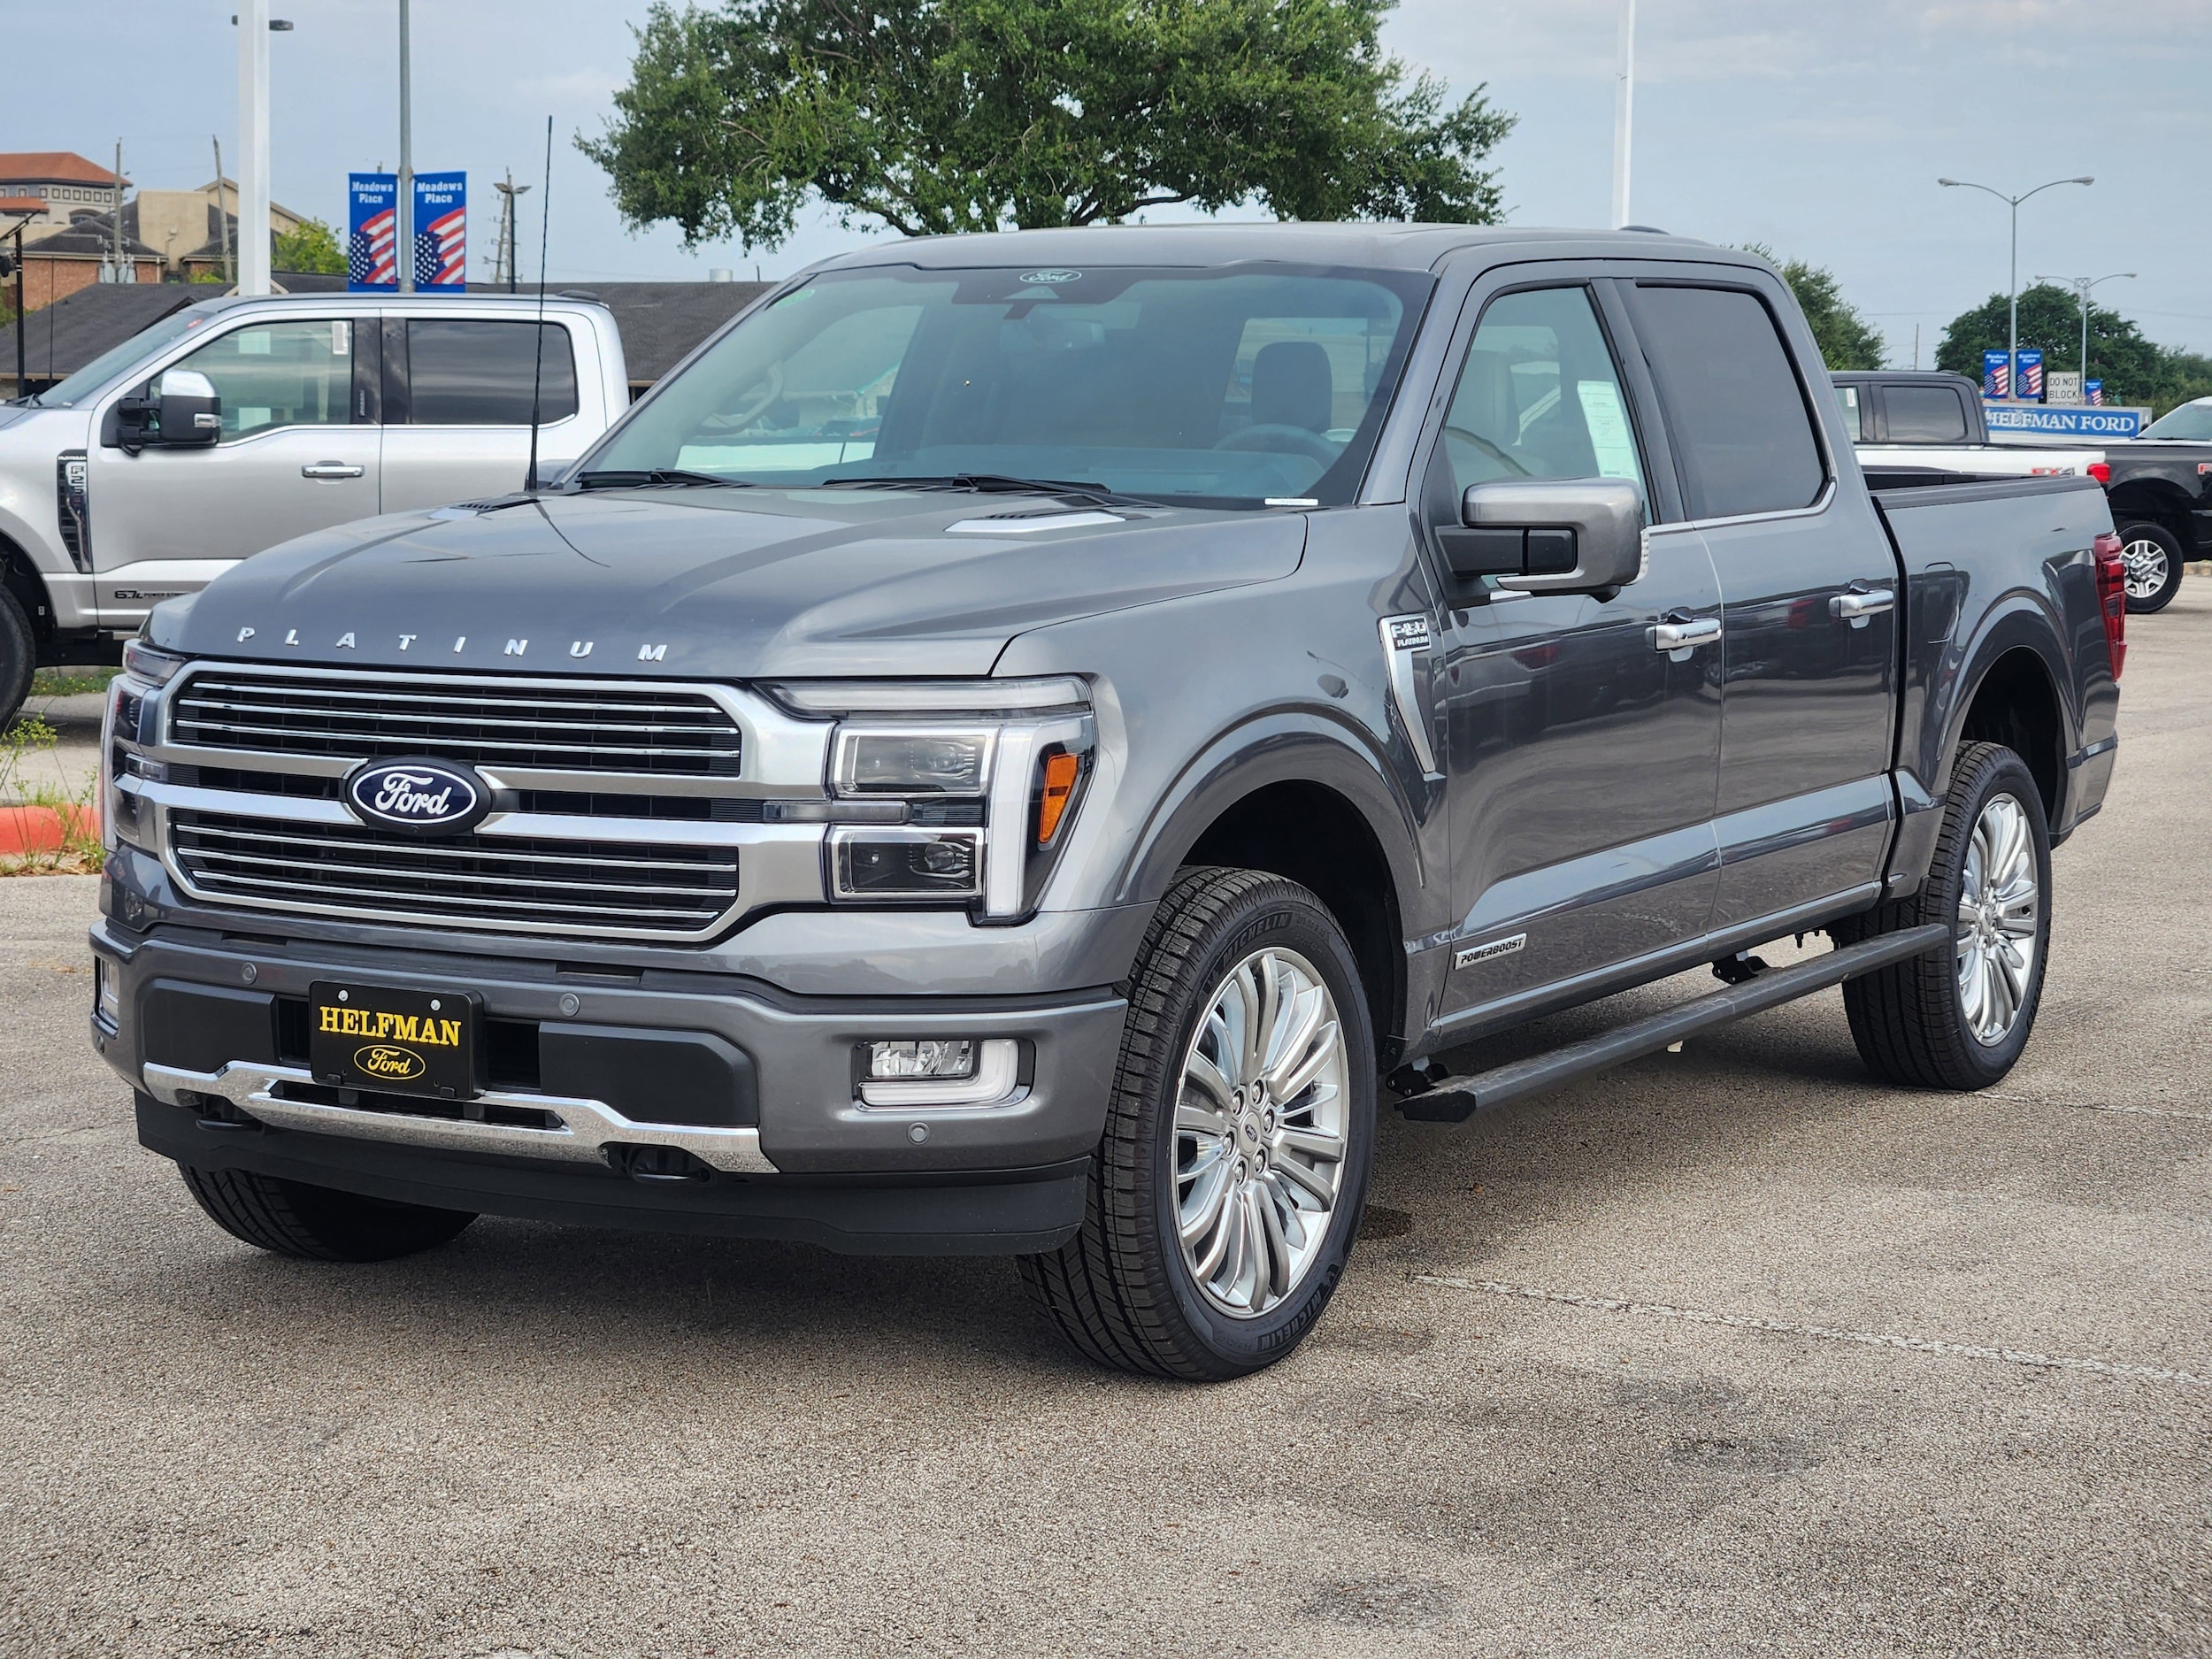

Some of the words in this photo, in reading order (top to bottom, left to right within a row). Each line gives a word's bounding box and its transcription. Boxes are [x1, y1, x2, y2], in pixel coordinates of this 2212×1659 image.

[351, 181, 394, 192] Meadows
[416, 181, 463, 193] Meadows
[358, 193, 383, 204] Place
[425, 193, 453, 204] Place
[2049, 377, 2061, 387] DO
[2062, 377, 2078, 387] NOT
[2049, 389, 2078, 399] BLOCK
[1986, 411, 2077, 430] HELFMAN
[2080, 416, 2135, 432] FORD
[114, 589, 143, 599] 6.7L
[1391, 621, 1427, 638] F-150
[236, 626, 668, 662] PLATINUM
[1397, 635, 1429, 648] PLATINUM
[375, 772, 453, 815] Ford
[1223, 914, 1292, 964] MICHELIN
[1461, 937, 1524, 964] POWERBOOST
[319, 1006, 462, 1047] HELFMAN
[367, 1048, 411, 1074] Ford
